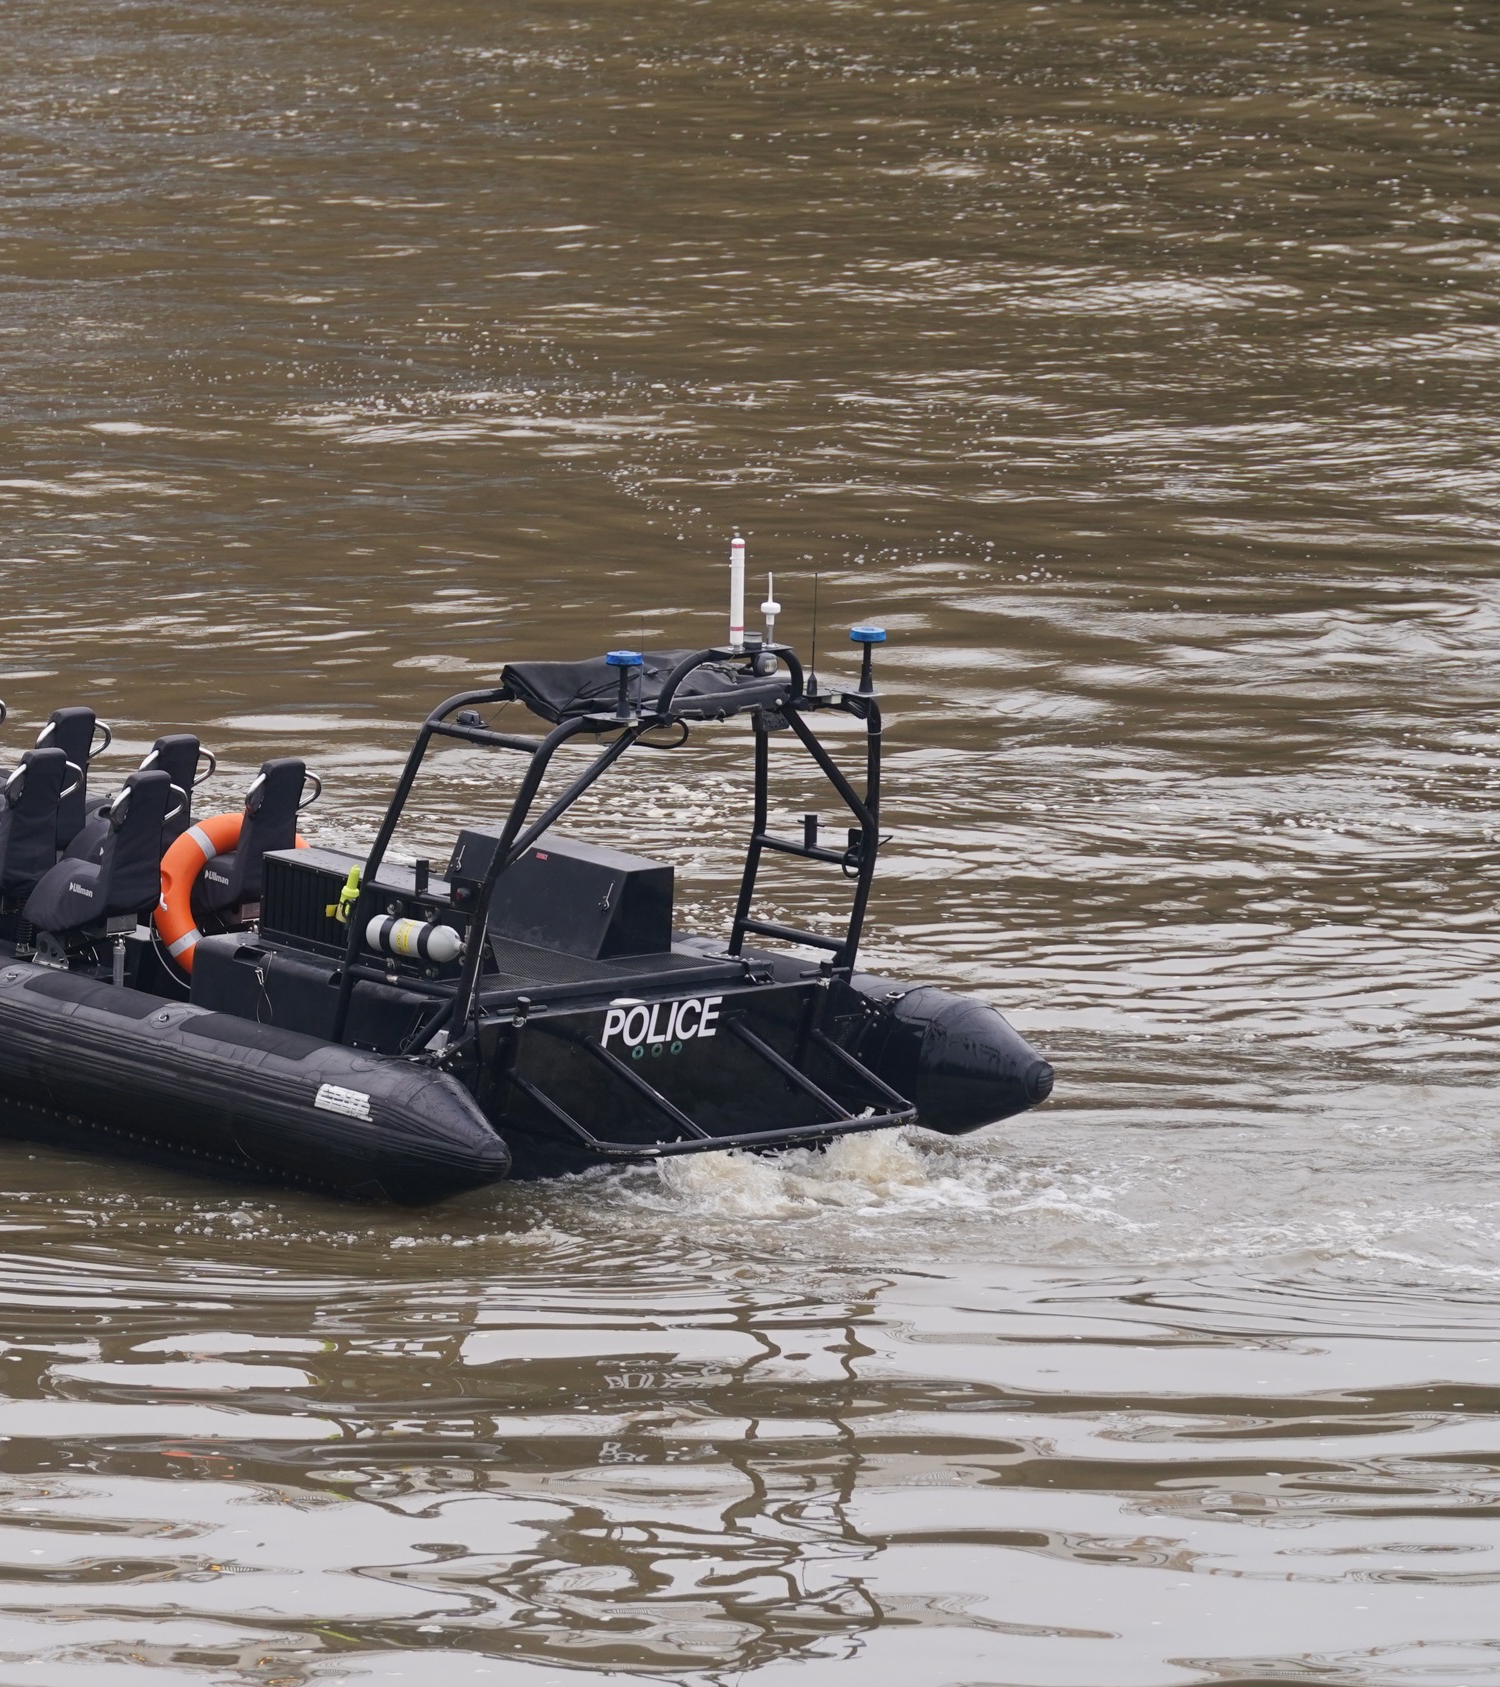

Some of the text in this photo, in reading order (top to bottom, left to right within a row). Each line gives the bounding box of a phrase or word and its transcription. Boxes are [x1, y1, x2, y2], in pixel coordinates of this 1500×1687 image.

[208, 870, 230, 886] Ullman
[73, 882, 94, 898] Ullman
[601, 996, 723, 1048] POLICE
